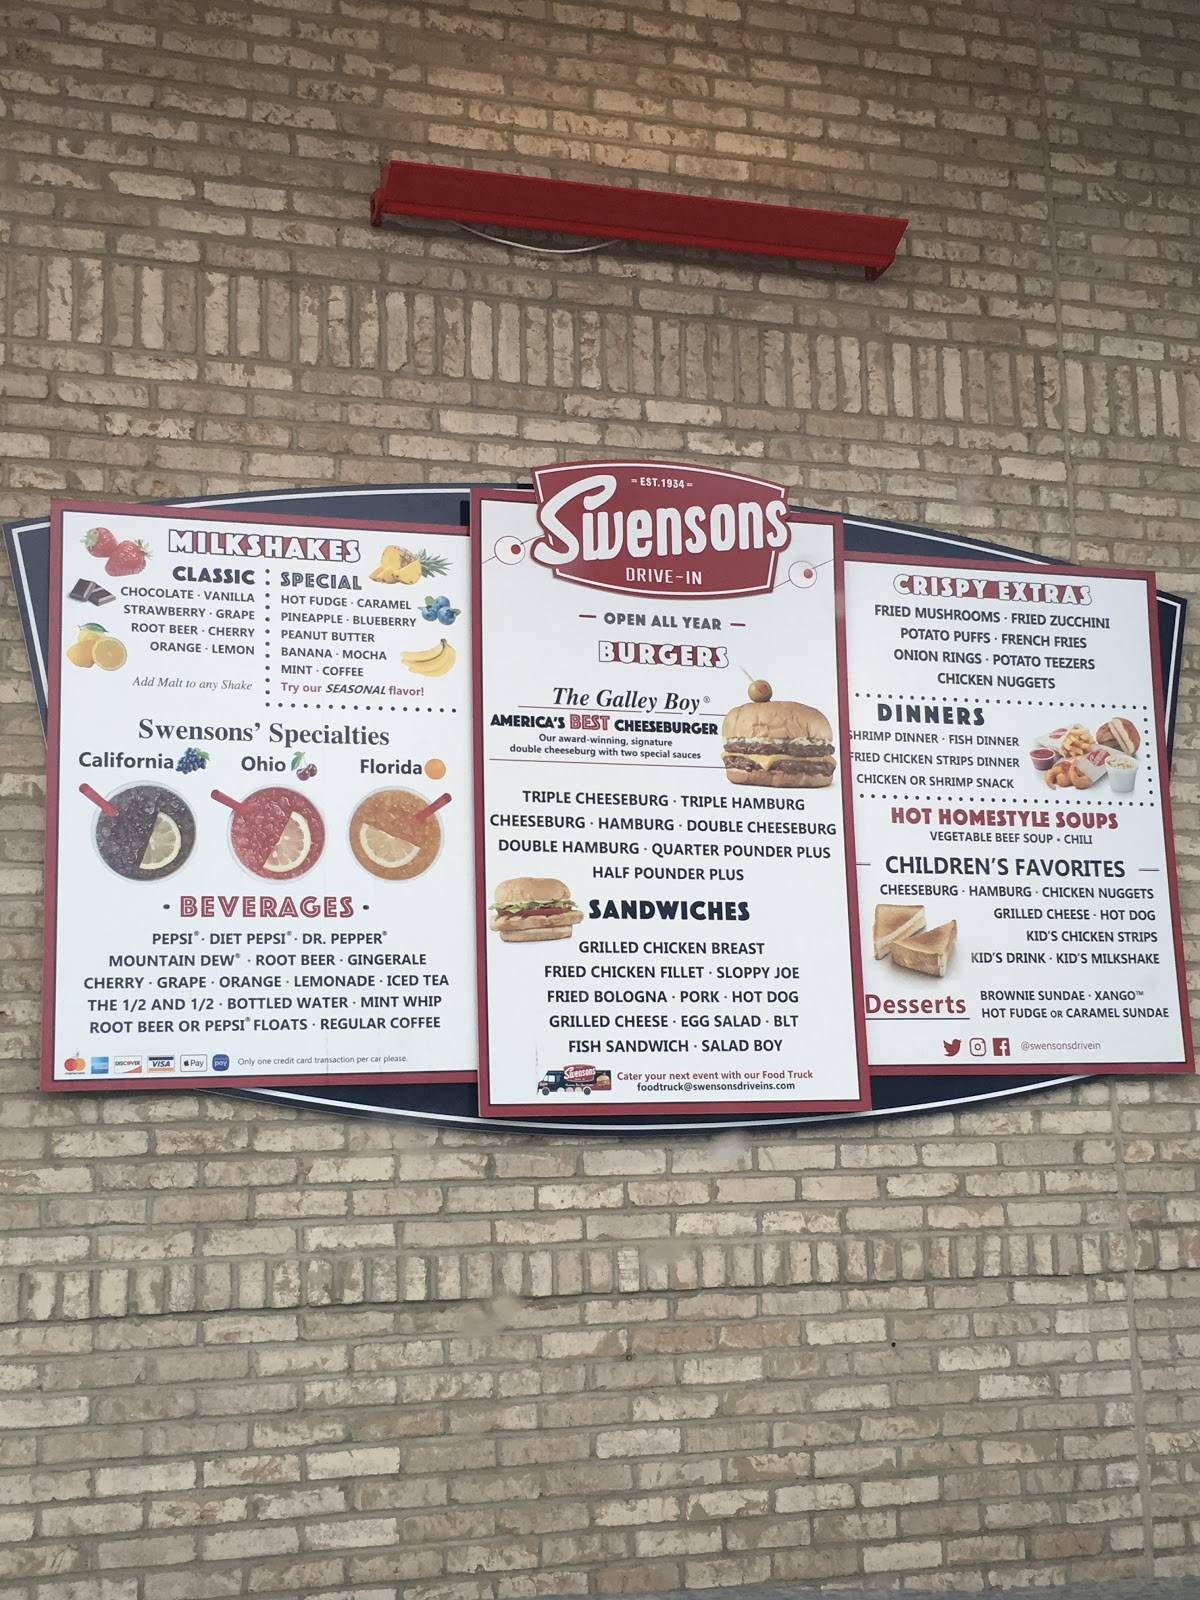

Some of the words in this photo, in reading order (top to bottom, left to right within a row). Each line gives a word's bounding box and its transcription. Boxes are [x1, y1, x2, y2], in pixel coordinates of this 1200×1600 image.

[533, 474, 788, 564] Swensons
[168, 529, 361, 563] MILKSHAKES
[173, 566, 255, 585] CLASSIC
[281, 572, 362, 590] SPECIAL
[626, 567, 702, 585] DRIVE-IN
[121, 587, 193, 599] CHOCOLATE
[204, 591, 255, 602] VANILLA
[893, 574, 989, 599] CRISPY
[997, 581, 1092, 605] EXTRAS
[281, 595, 306, 604] HOT
[310, 596, 347, 606] FUDGE
[357, 599, 411, 609] CARAMEL
[124, 605, 206, 617] STRAWBERRY
[216, 609, 254, 620] GRAPE
[281, 612, 343, 624] PINEAPPLE
[353, 616, 416, 627] BLUEBERRY
[875, 604, 911, 617] FRIED
[915, 607, 1000, 623] MUSHROOMS
[1012, 613, 1046, 625] FRIED
[1050, 615, 1110, 629] ZUCCHINI
[604, 612, 645, 626] OPEN
[651, 615, 678, 627] ALL
[682, 617, 721, 630] YEAR
[281, 630, 328, 640] PEANUT
[332, 632, 375, 642] BUTTER
[599, 640, 729, 668] BURGERS
[894, 649, 938, 662] ONION
[943, 652, 982, 664] RINGS
[993, 654, 1041, 667] POTATO
[1044, 657, 1095, 670] TEEZERS
[282, 665, 312, 674] MINT
[323, 666, 363, 677] COFFEE
[134, 677, 155, 686] Add
[159, 678, 182, 687] Malt
[185, 678, 196, 689] to
[199, 679, 218, 692] any
[221, 680, 252, 690] Shake
[938, 673, 992, 686] CHICKEN
[997, 676, 1055, 689] NUGGETS
[281, 682, 299, 694] Try
[326, 684, 386, 695] SEASONAL
[389, 686, 424, 696] flavor!
[552, 687, 590, 706] The
[596, 689, 658, 713] Galley
[878, 703, 984, 726] DINNERS
[490, 714, 565, 729] AMERICA'S
[570, 714, 610, 730] BEST
[614, 719, 718, 735] CHEESEBURGER
[139, 719, 260, 741] Swensons'
[270, 723, 389, 748] Specialties
[539, 734, 556, 742] Our
[559, 735, 628, 747] award-winning,
[631, 737, 672, 747] signature
[895, 732, 938, 743] DINNER
[949, 735, 972, 744] FISH
[977, 736, 1019, 746] DINNER
[510, 744, 542, 753] double
[544, 746, 595, 757] cheeseburg
[599, 748, 618, 756] with
[640, 750, 670, 759] special
[79, 752, 173, 769] California
[241, 756, 286, 771] Ohio
[361, 759, 422, 774] Florida
[857, 774, 906, 785] CHICKEN
[910, 776, 926, 785] OR
[929, 776, 973, 787] SHRIMP
[976, 778, 1014, 788] SNACK
[522, 790, 571, 803] TRIPLE
[576, 792, 668, 806] CHEESEBURG
[680, 796, 727, 808] TRIPLE
[732, 797, 804, 810] HAMBURG
[892, 807, 932, 824] HOT
[939, 809, 1049, 827] HOMESTYLE
[1056, 812, 1118, 829] SOUPS
[930, 831, 992, 842] VEGETABLE
[995, 833, 1020, 842] BEEF
[1024, 833, 1053, 843] SOUP
[1064, 835, 1092, 844] CHILI
[499, 839, 558, 852] DOUBLE
[563, 841, 639, 854] HAMBURG
[652, 843, 719, 858] QUARTER
[724, 845, 793, 857] POUNDER
[797, 847, 830, 858] PLUS
[593, 866, 629, 878] HALF
[635, 867, 705, 880] POUNDER
[710, 869, 744, 881] PLUS
[886, 856, 1008, 875] CHILDREN'S
[1016, 859, 1125, 878] FAVORITES
[181, 896, 354, 918] BEVERAGES
[589, 899, 750, 921] SANDWICHES
[1027, 931, 1058, 941] KID'S
[1062, 931, 1114, 942] CHICKEN
[1118, 932, 1158, 942] STRIPS
[579, 941, 638, 953] GRILLED
[643, 942, 706, 954] CHICKEN
[712, 943, 765, 954] BREAST
[971, 952, 1002, 963] KID'S
[1007, 953, 1046, 963] DRINK
[1056, 953, 1087, 964] KID'S
[1092, 953, 1160, 964] MILKSHAKE
[84, 977, 144, 989] CHERRY
[157, 977, 206, 988] GRAPE
[219, 976, 281, 988] ORANGE
[295, 975, 375, 987] LEMONADE
[387, 975, 419, 986] ICED
[423, 975, 449, 986] TEA
[88, 1000, 117, 1011] THE
[123, 999, 146, 1012] 1/2
[151, 999, 185, 1010] AND
[191, 998, 214, 1011] 1/2
[228, 998, 292, 1009] BOTTLED
[297, 997, 348, 1008] WATER
[361, 996, 399, 1007] MINT
[403, 996, 442, 1007] WHIP
[548, 990, 589, 1002] FRIED
[594, 991, 667, 1003] BOLOGNA
[680, 991, 720, 1003] PORK
[732, 991, 763, 1003] HOT
[767, 991, 798, 1003] DOG
[865, 994, 966, 1014] Desserts
[982, 1008, 1006, 1018] HOT
[1010, 1008, 1047, 1018] FUDGE
[1050, 1010, 1063, 1018] OR
[1066, 1008, 1120, 1018] CARAMEL
[1123, 1008, 1169, 1018] SUNDAE
[1021, 1040, 1101, 1051] @swensonsdrivein
[191, 1059, 203, 1067] Pay
[617, 1072, 642, 1080] Cater
[645, 1074, 666, 1082] your
[721, 1071, 741, 1079] with
[763, 1070, 785, 1078] Food
[788, 1070, 813, 1078] Truck
[637, 1081, 795, 1091] foodtruck@swensonsdriveins.com
